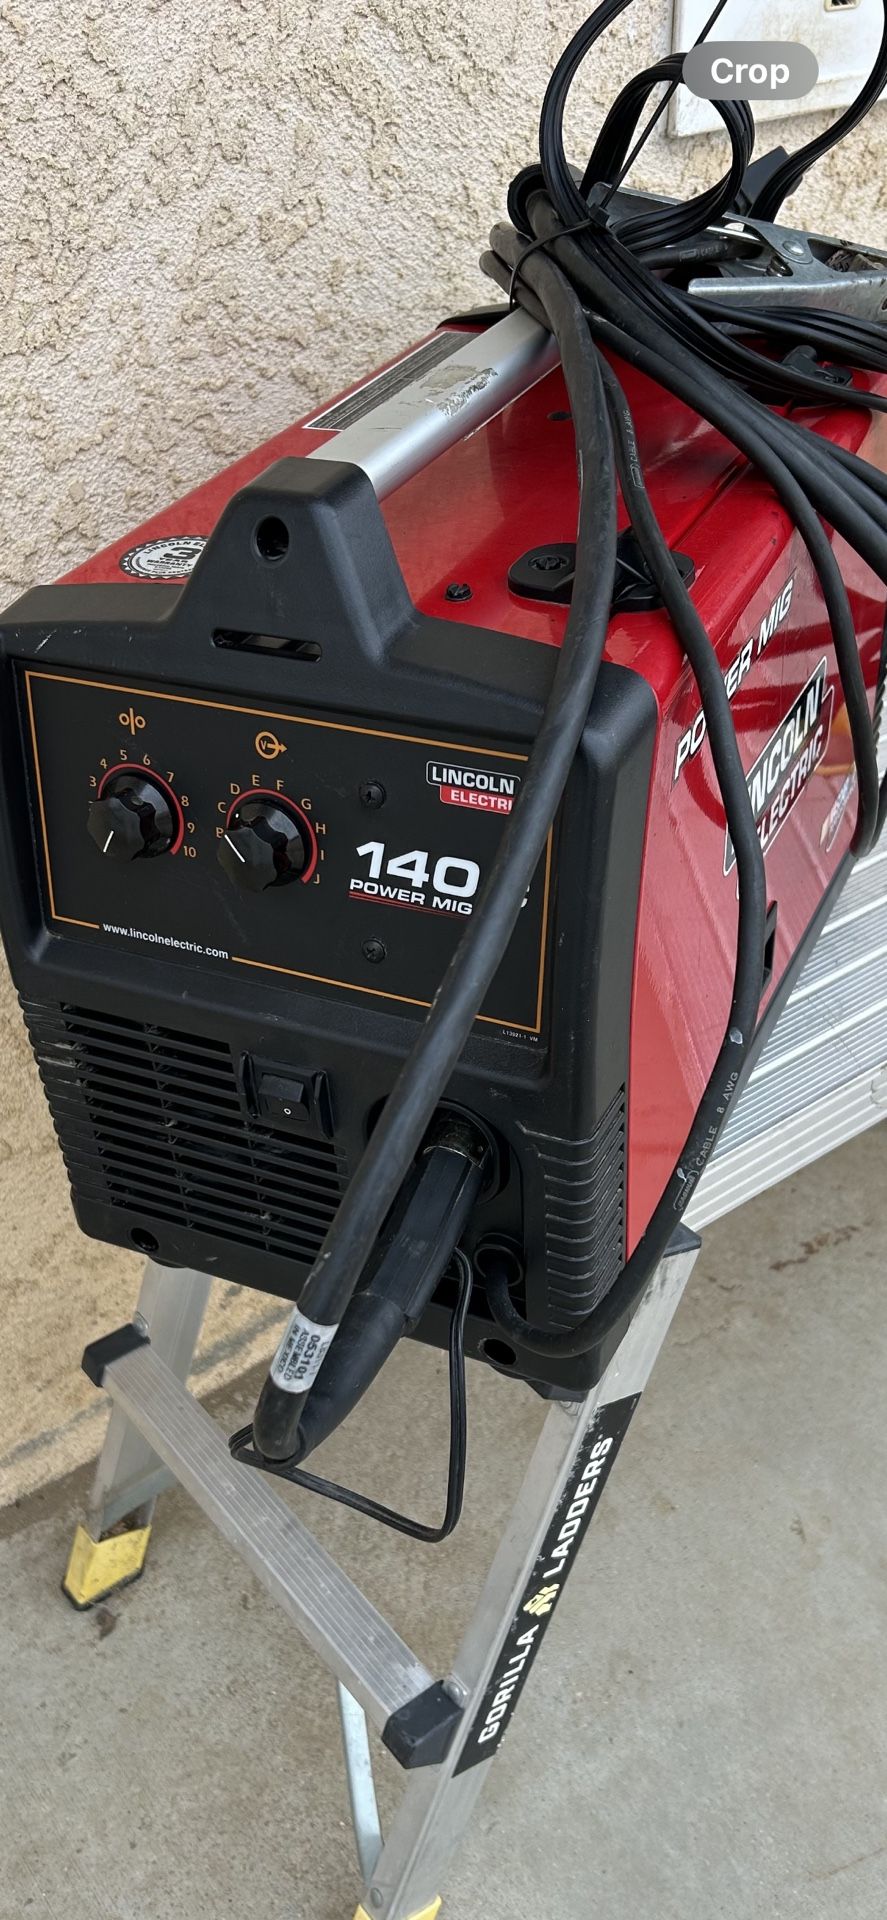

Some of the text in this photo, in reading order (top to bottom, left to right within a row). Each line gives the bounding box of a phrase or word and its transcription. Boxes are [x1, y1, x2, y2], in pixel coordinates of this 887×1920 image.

[143, 541, 191, 554] LINCOLN
[163, 547, 202, 560] 3
[674, 579, 794, 781] POER MIG
[746, 676, 821, 817] NCOLN
[120, 750, 128, 761] 5
[143, 754, 151, 766] 6
[100, 758, 108, 769] 4
[89, 776, 97, 787] 3
[167, 771, 175, 783] 7
[252, 774, 260, 786] E
[432, 766, 515, 795] LINCOLN
[230, 783, 240, 795] D
[276, 780, 284, 791] F
[757, 724, 824, 850] LECTRIC
[181, 795, 189, 807] 8
[217, 802, 226, 813] C
[301, 798, 311, 810] G
[451, 790, 513, 812] ELECTRI
[187, 823, 195, 834] 9
[315, 822, 326, 835] H
[184, 846, 197, 857] 10
[356, 841, 530, 907] 140
[350, 878, 473, 915] POWER MIG
[103, 923, 229, 960] www.lincolnelectric.com
[695, 1125, 718, 1167] CABLE
[716, 1106, 725, 1114] 8
[722, 1072, 739, 1102] AWG
[283, 1328, 309, 1381] ASSEMBLED
[294, 1334, 321, 1380] 053101
[478, 1436, 614, 1744] GORILLA LADDERS
